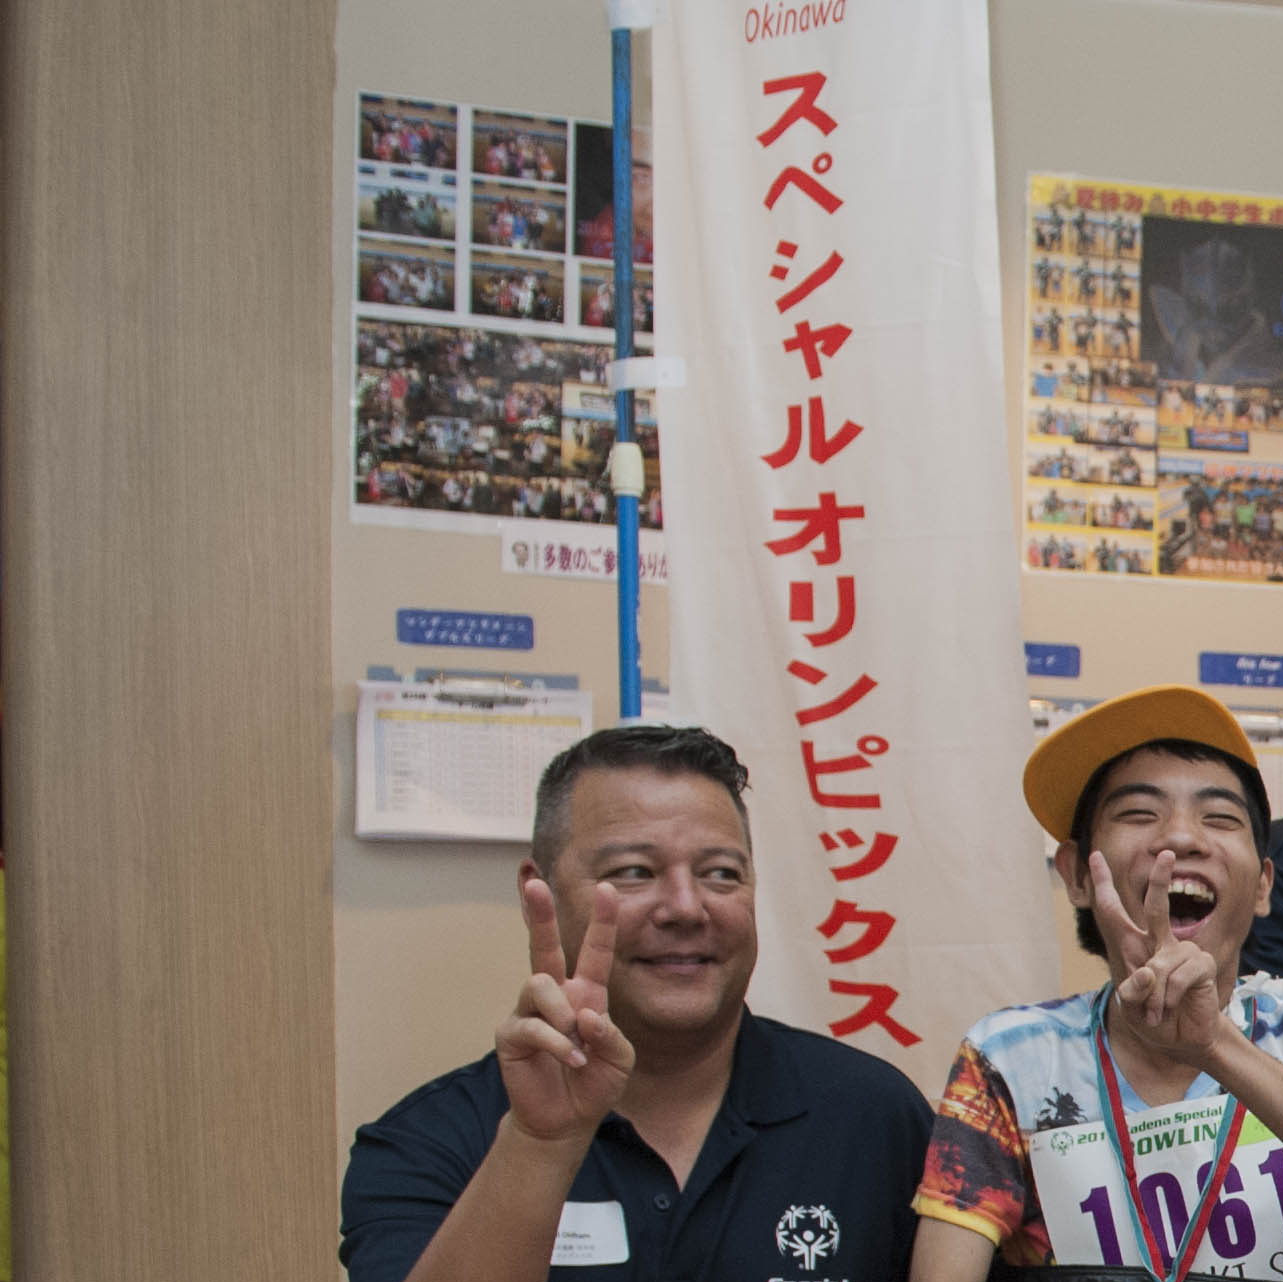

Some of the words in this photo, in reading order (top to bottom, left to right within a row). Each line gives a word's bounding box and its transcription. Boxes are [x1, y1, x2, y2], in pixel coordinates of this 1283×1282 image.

[744, 0, 846, 43] Okinawa
[756, 71, 922, 1048] スペシャルオリンピックス
[1077, 1131, 1106, 1145] 201
[1130, 1116, 1172, 1134] adena
[1174, 1105, 1222, 1125] Special
[1131, 1120, 1221, 1157] OWLIN
